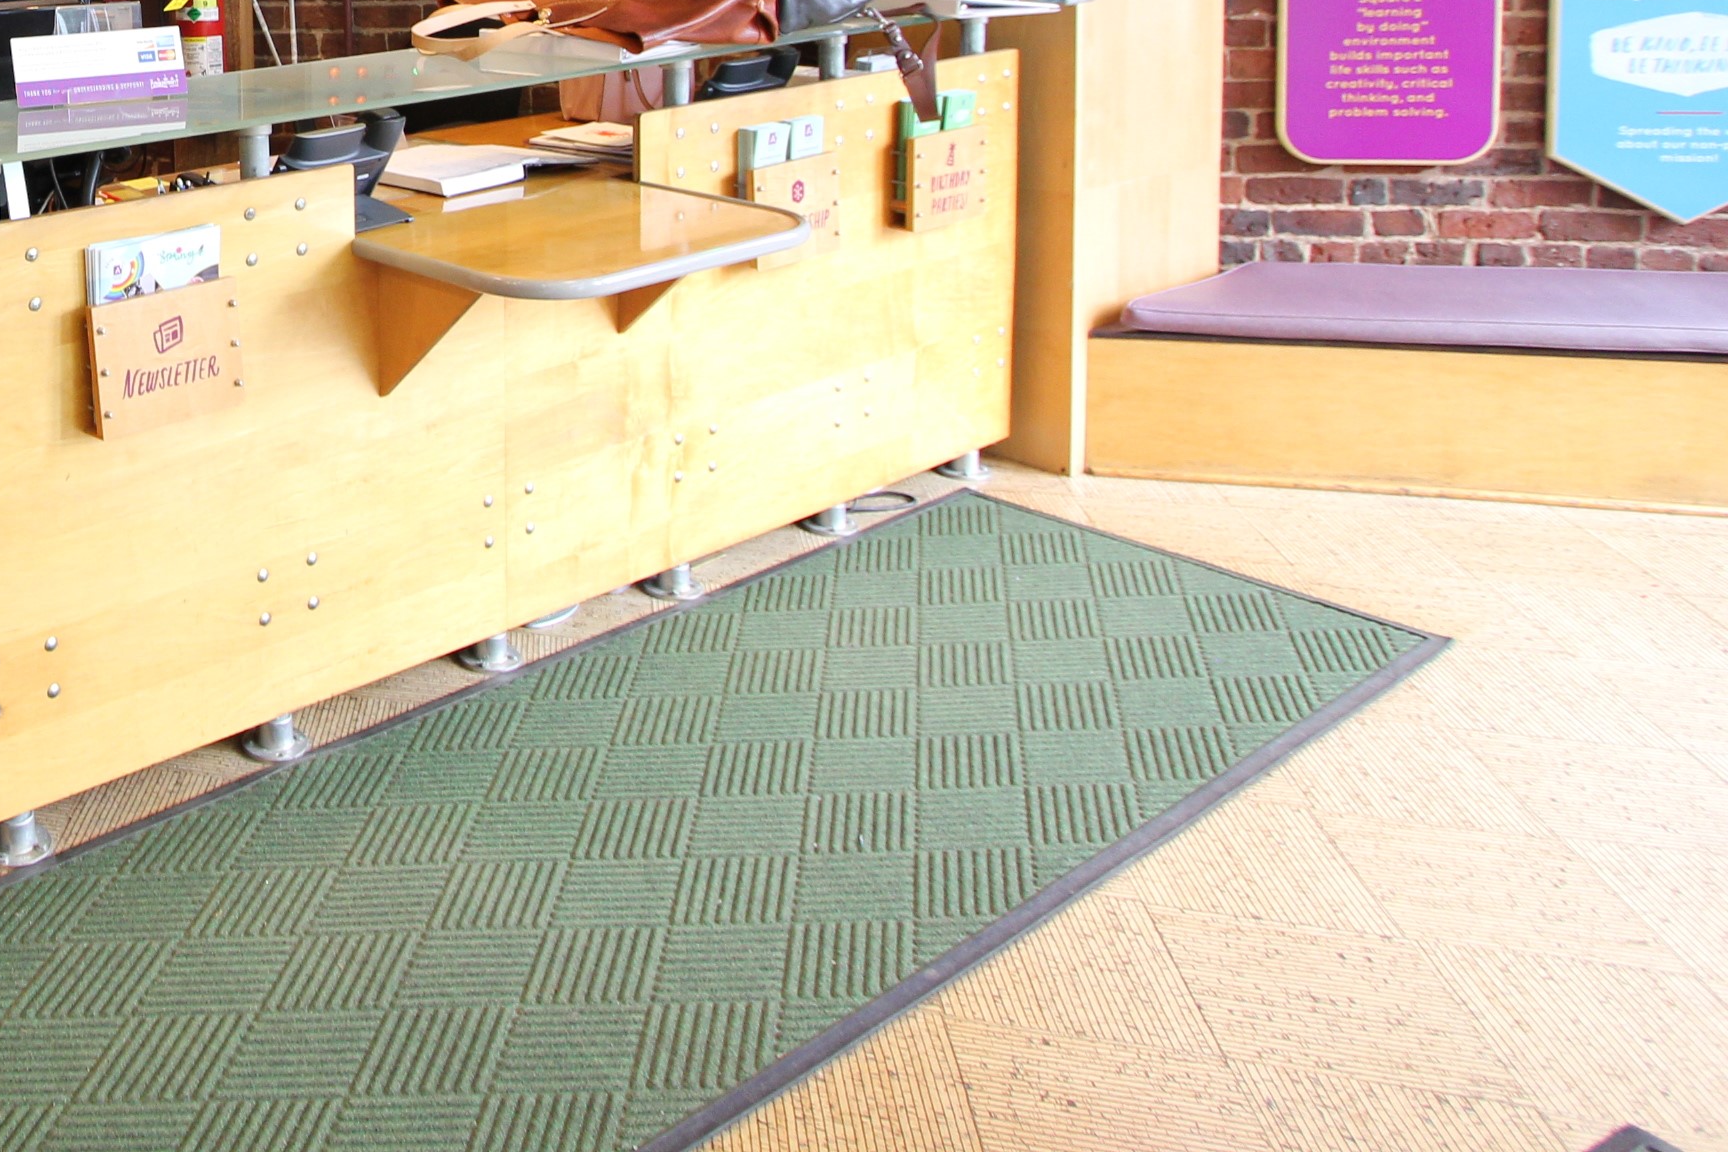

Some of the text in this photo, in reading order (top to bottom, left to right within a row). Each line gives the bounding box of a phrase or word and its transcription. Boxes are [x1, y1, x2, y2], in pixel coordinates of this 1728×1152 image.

[1356, 22, 1375, 33] by
[1343, 35, 1436, 46] environment
[140, 53, 154, 61] VISA
[1329, 49, 1450, 61] builds important
[1329, 63, 1449, 75] life skills such as
[1325, 78, 1454, 91] creativity, critical
[1406, 93, 1435, 103] and
[1328, 107, 1449, 119] problem solving.
[1617, 125, 1720, 137] Spreading the
[1615, 140, 1659, 149] about
[930, 169, 971, 193] BIRTHDAY
[122, 355, 220, 400] NEWSLETTER
